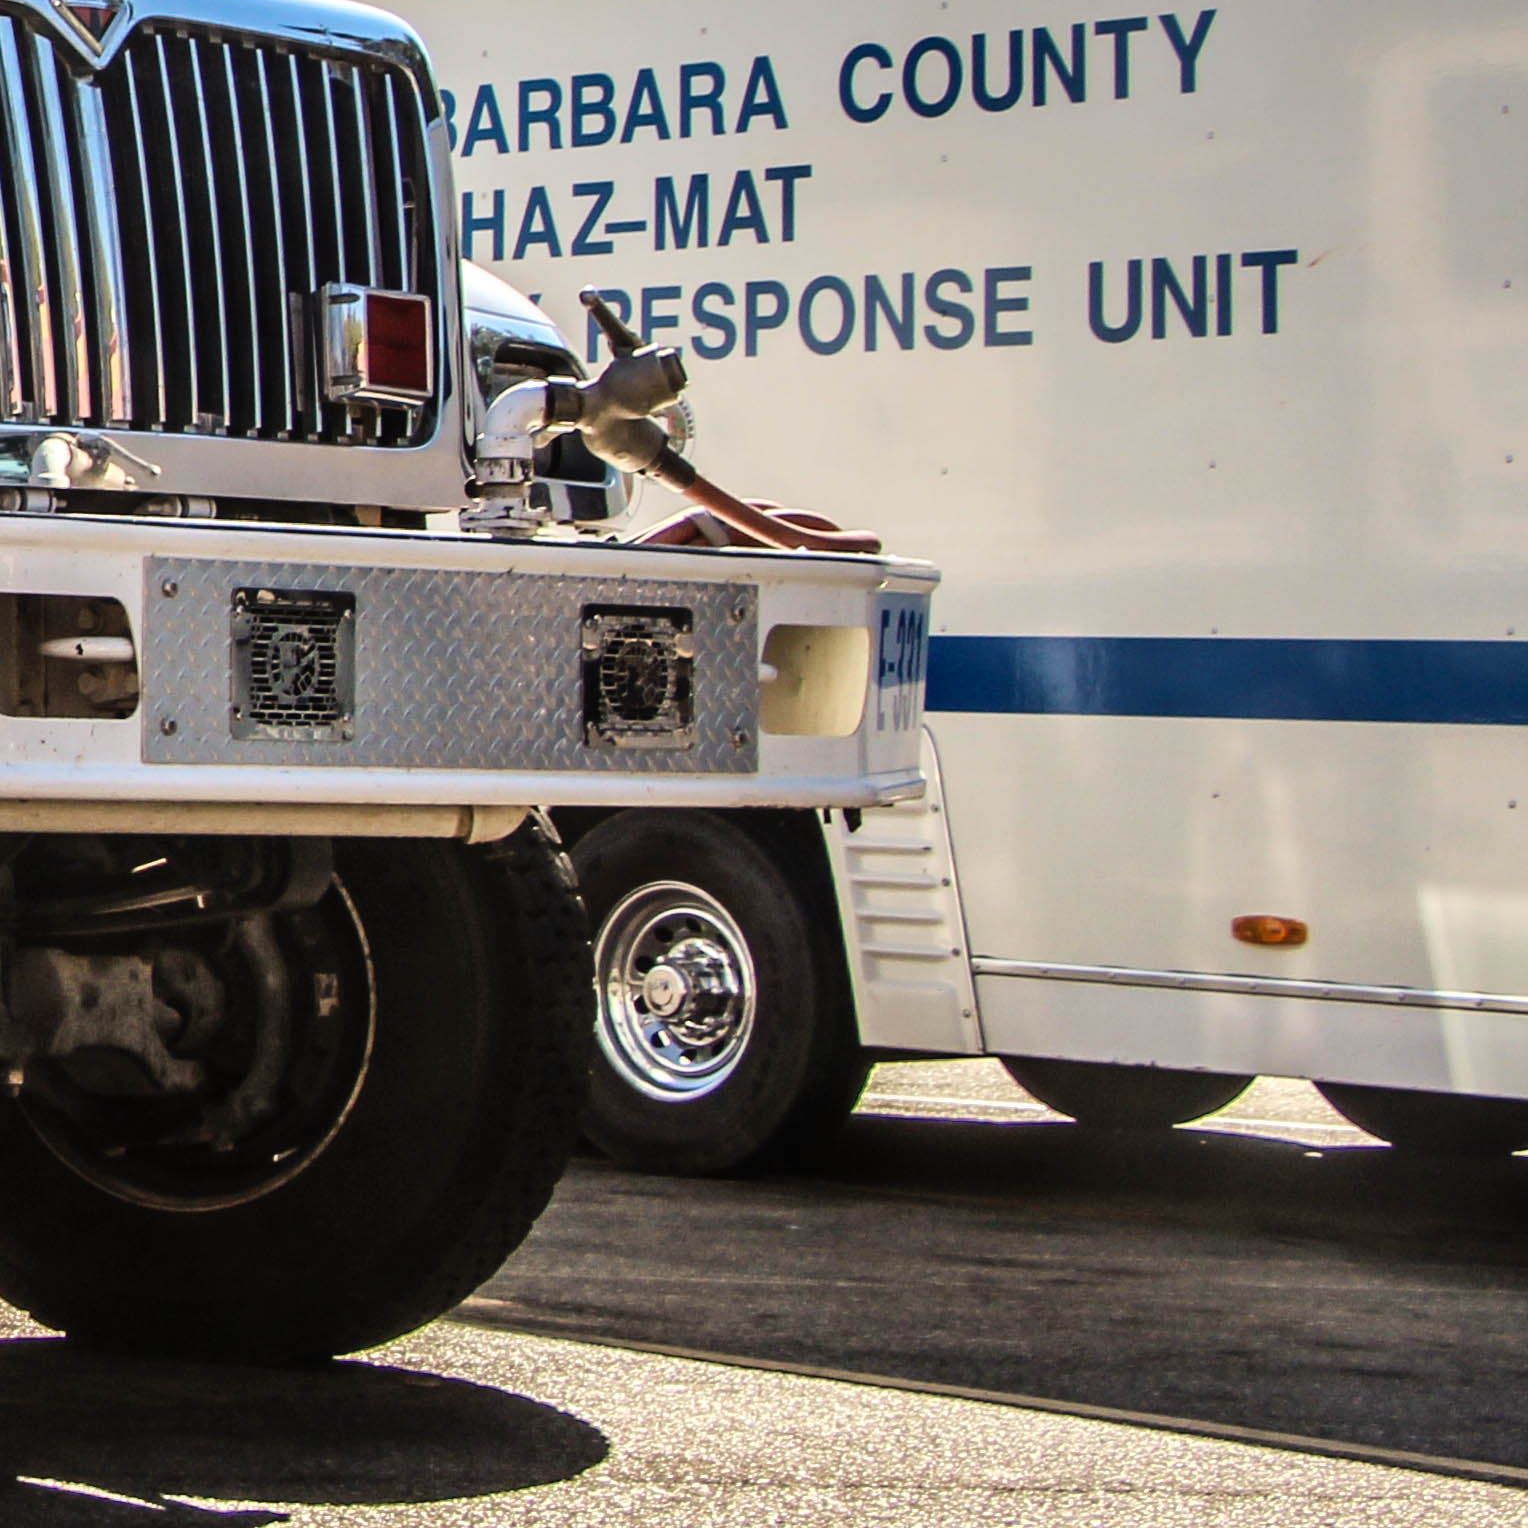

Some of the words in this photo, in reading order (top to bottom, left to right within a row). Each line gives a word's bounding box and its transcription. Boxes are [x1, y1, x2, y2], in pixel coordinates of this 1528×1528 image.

[839, 10, 1217, 124] COUNTY
[460, 164, 813, 262] HAZ-MAT
[1088, 249, 1299, 344] UNIT
[876, 608, 924, 731] E-331
